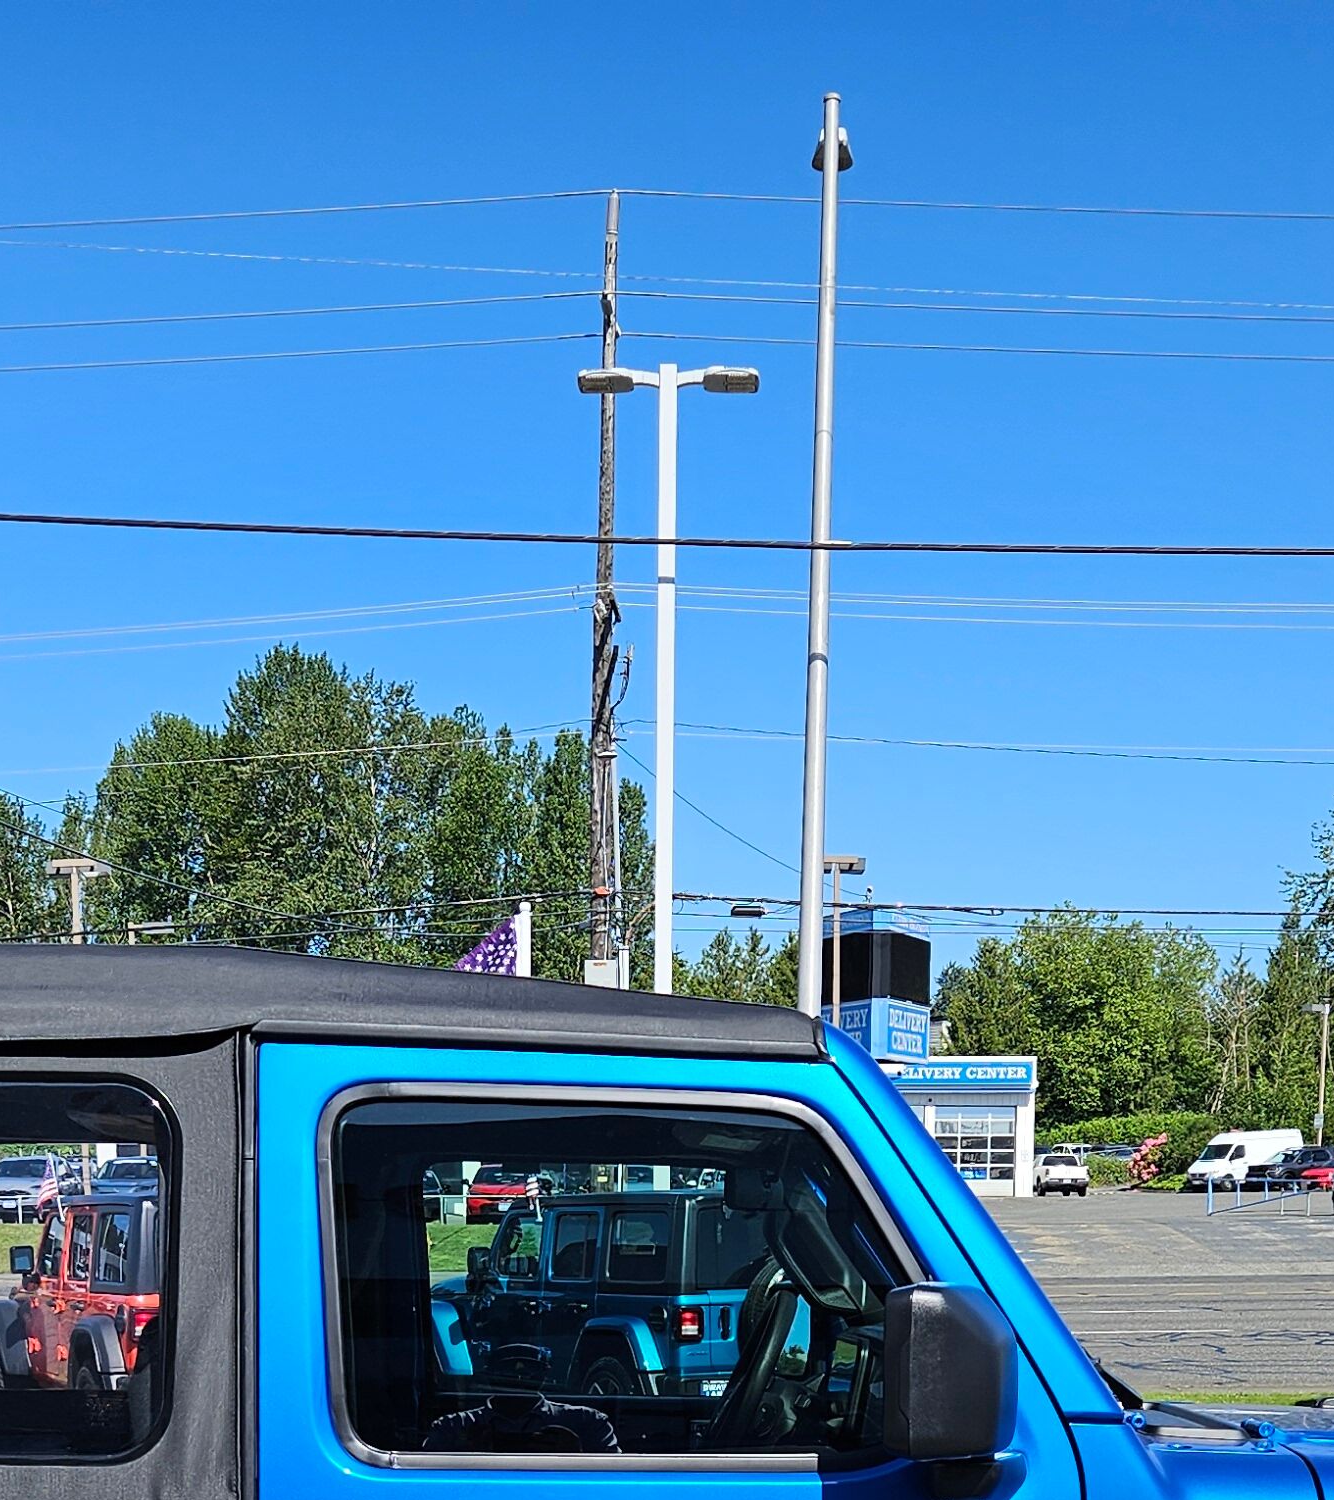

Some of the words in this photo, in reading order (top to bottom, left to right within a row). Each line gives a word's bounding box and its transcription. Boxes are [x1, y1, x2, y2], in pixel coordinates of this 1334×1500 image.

[889, 1008, 927, 1033] DELIVERY
[892, 1030, 923, 1054] CENTER
[901, 1067, 963, 1080] ELIVERY
[965, 1067, 1028, 1080] CENTER
